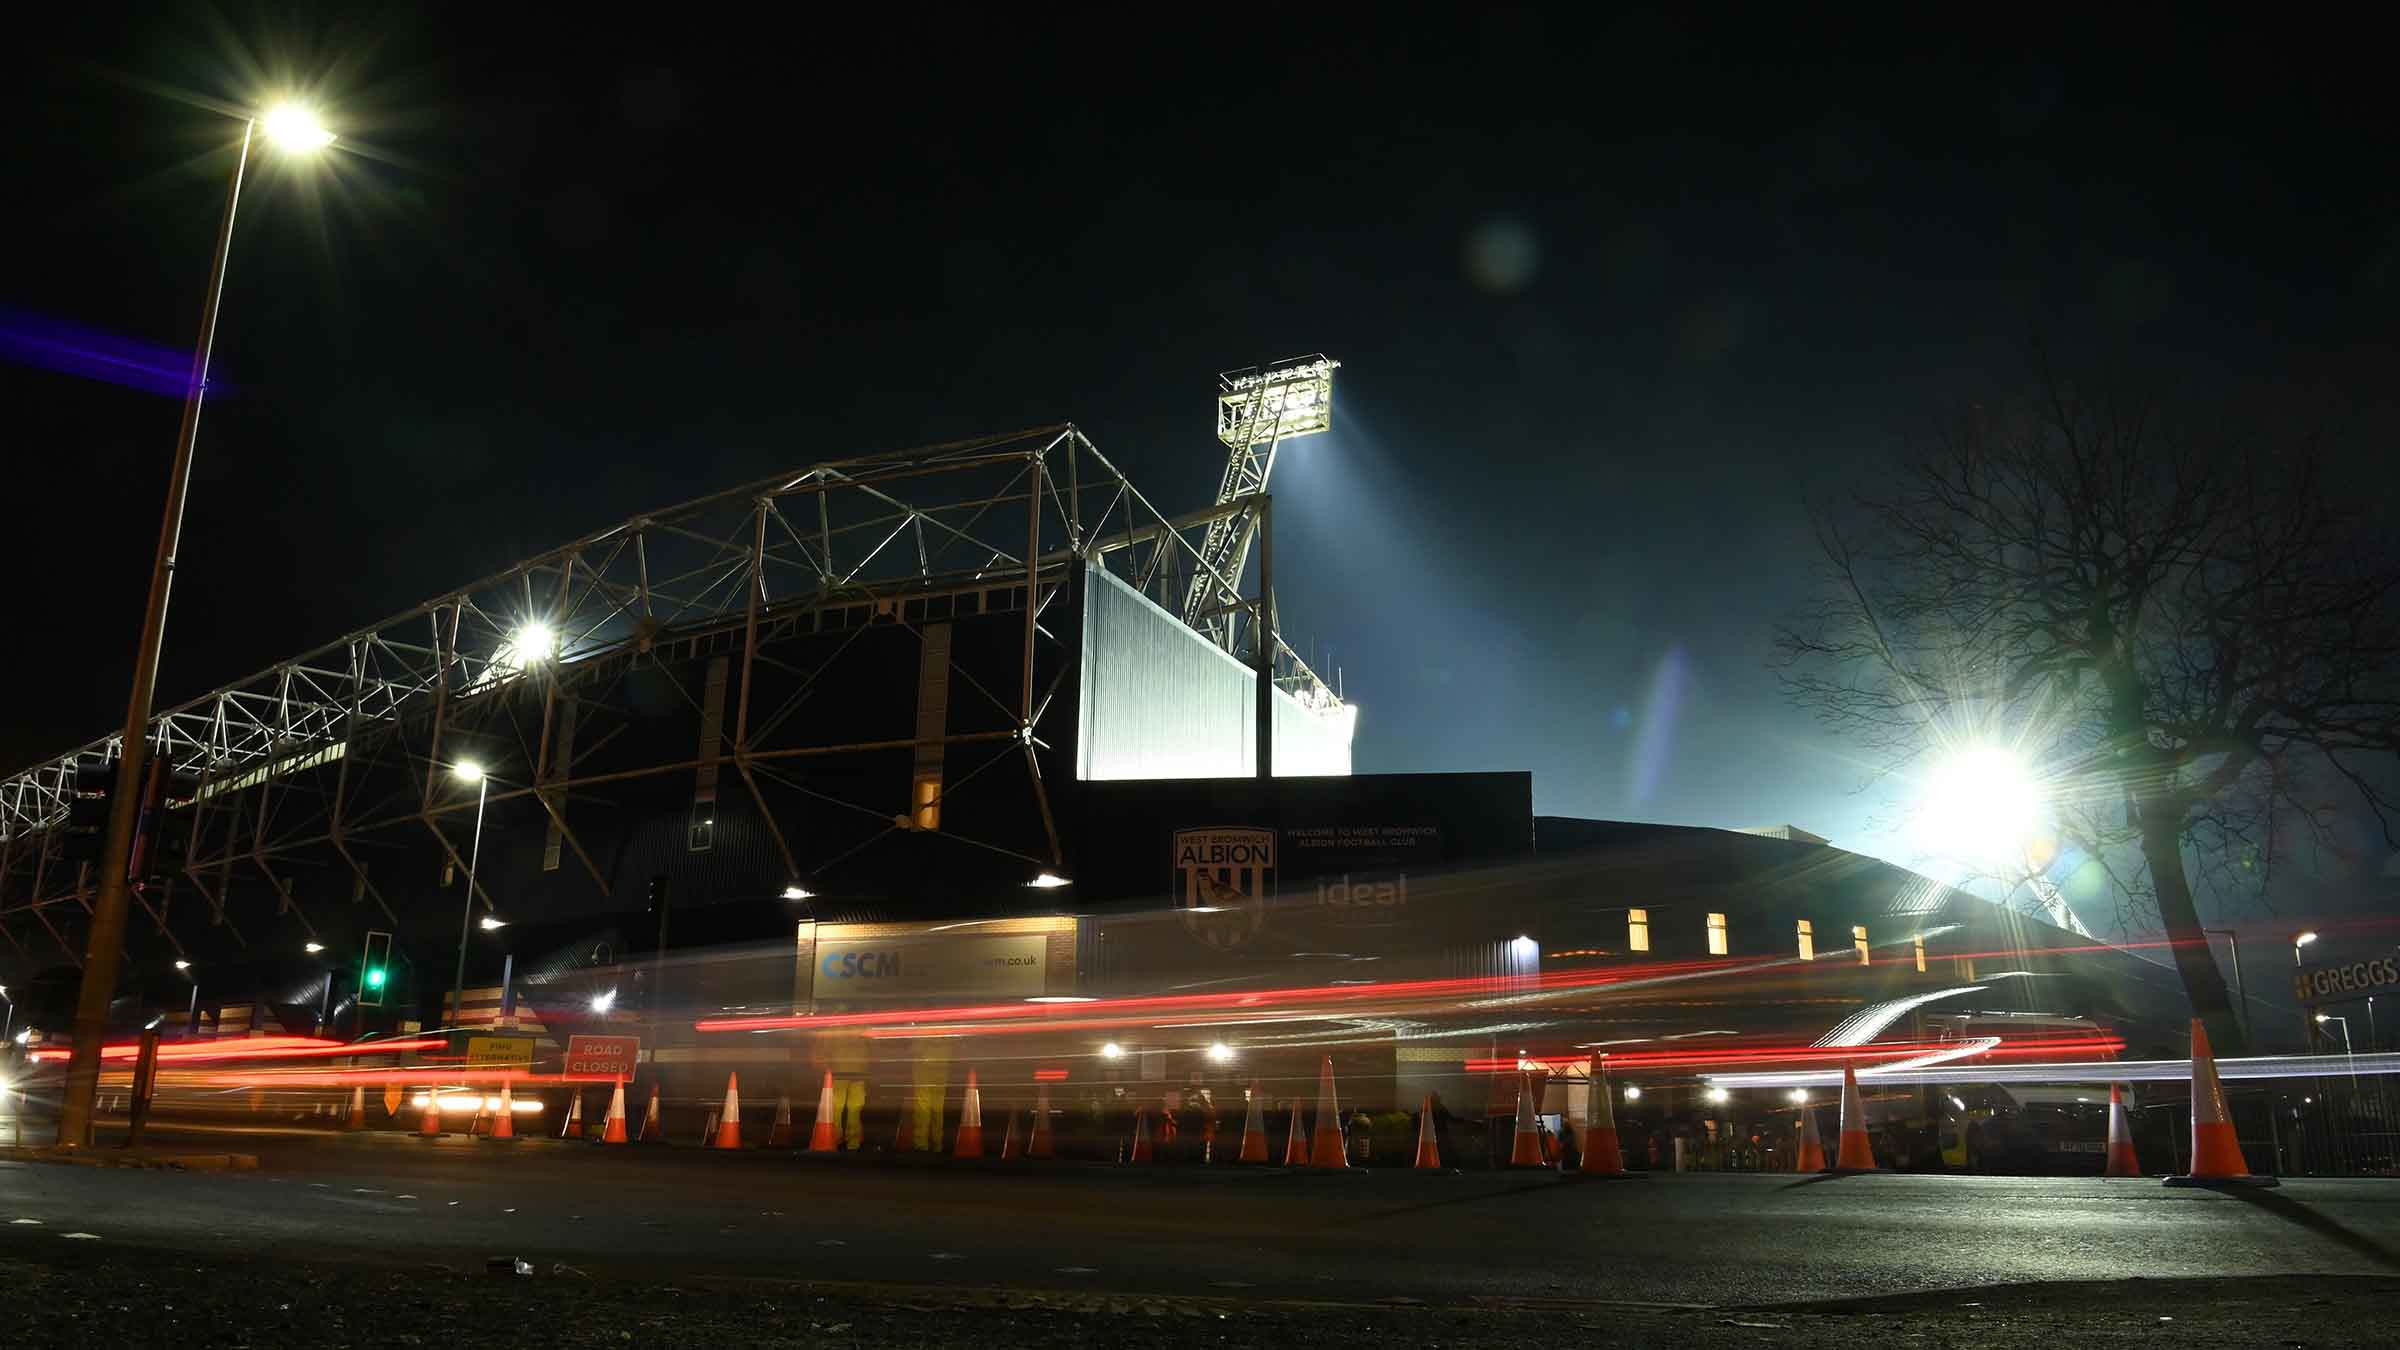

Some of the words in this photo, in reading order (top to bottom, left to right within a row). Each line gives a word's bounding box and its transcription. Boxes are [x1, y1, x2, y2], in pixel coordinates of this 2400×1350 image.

[1181, 834, 1208, 844] WEST
[1180, 845, 1269, 864] ALBION
[1316, 872, 1408, 905] ideal
[821, 952, 898, 978] CSCM
[2314, 958, 2399, 994] GREGGS
[583, 1045, 623, 1056] ROAD
[572, 1062, 629, 1073] CLOSED
